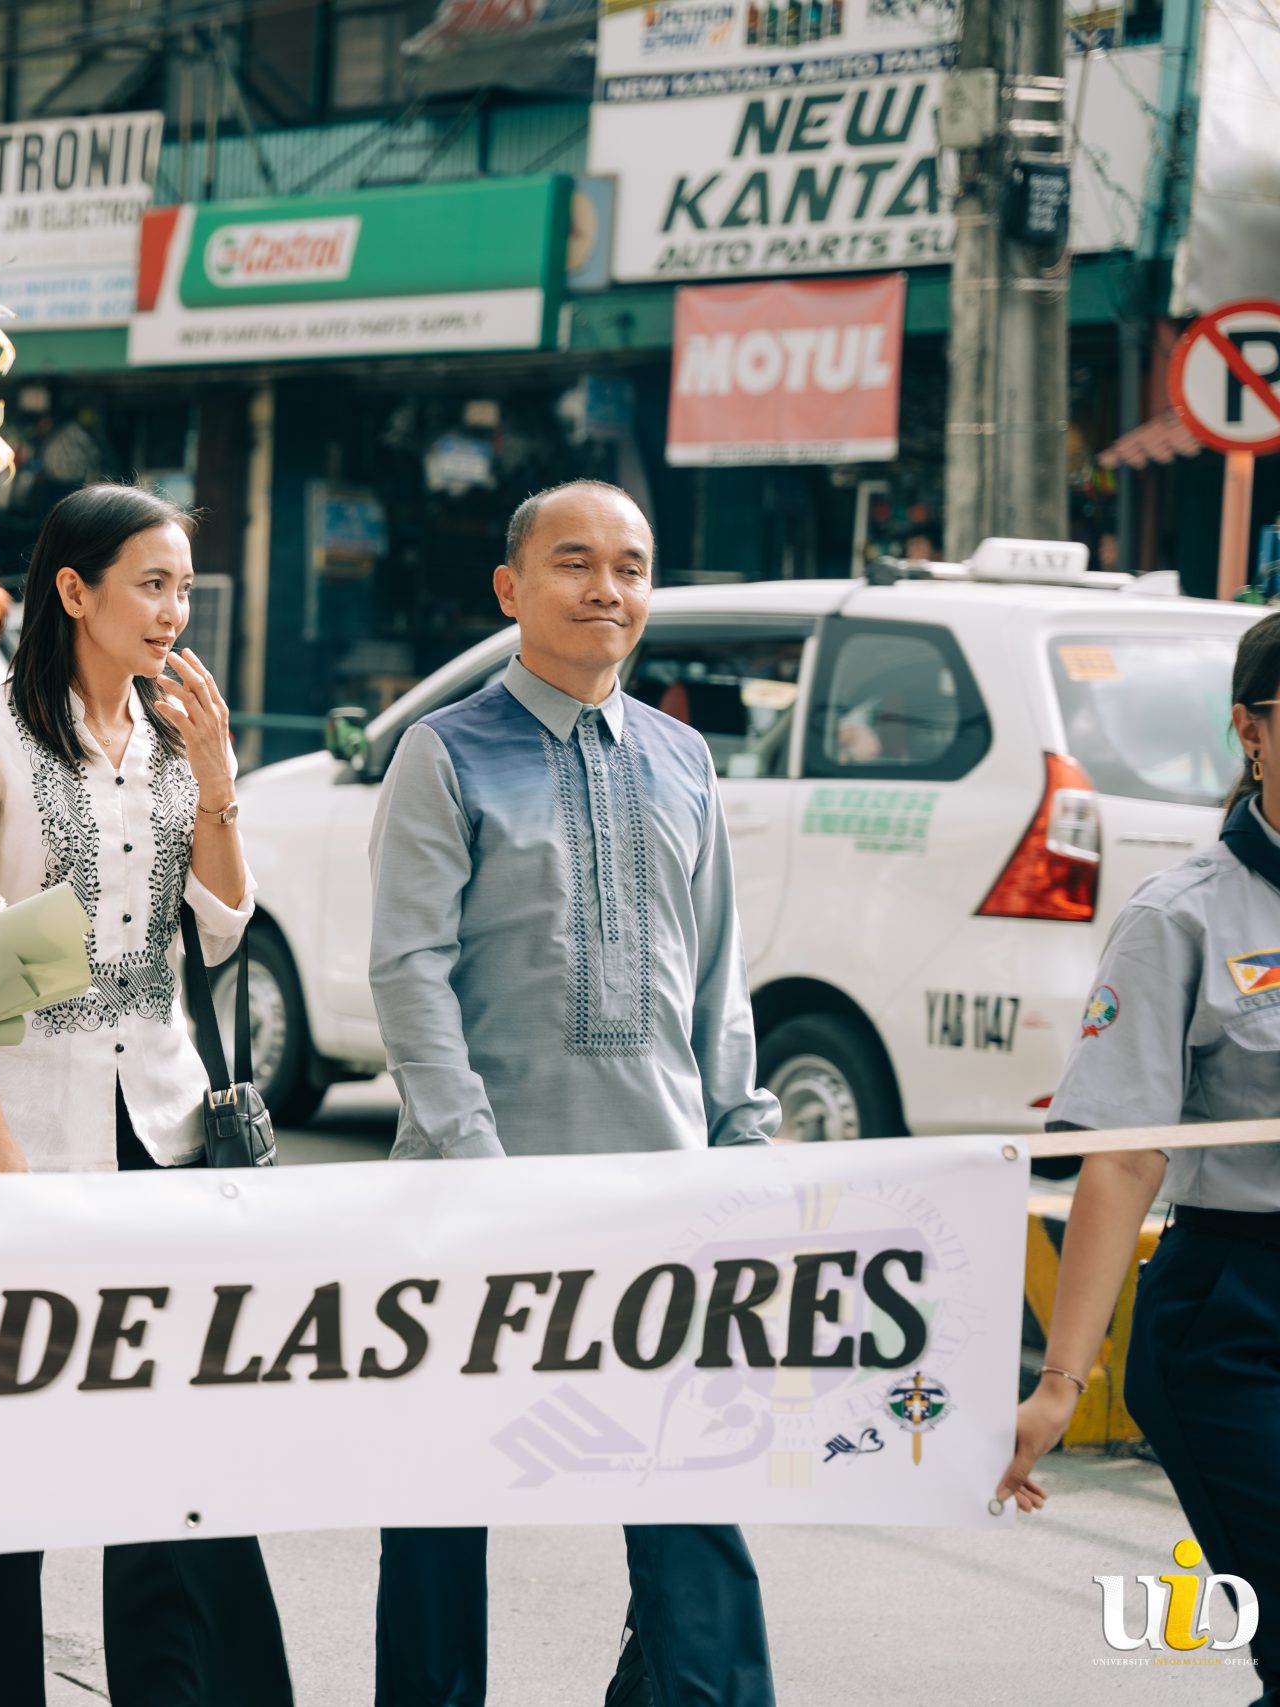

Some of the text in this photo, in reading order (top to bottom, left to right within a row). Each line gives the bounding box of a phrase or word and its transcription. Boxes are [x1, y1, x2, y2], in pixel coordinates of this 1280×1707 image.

[607, 76, 668, 101] NEW
[799, 53, 879, 80] AUTO
[732, 83, 927, 157] NEW
[661, 157, 939, 232] KANTA
[657, 238, 752, 271] AUTO
[765, 230, 891, 267] PARTS
[676, 323, 891, 396] MOTUL
[1227, 331, 1280, 422] P
[1010, 551, 1071, 569] TAXI
[188, 1278, 441, 1386] LAS
[460, 1248, 928, 1374] FLORES
